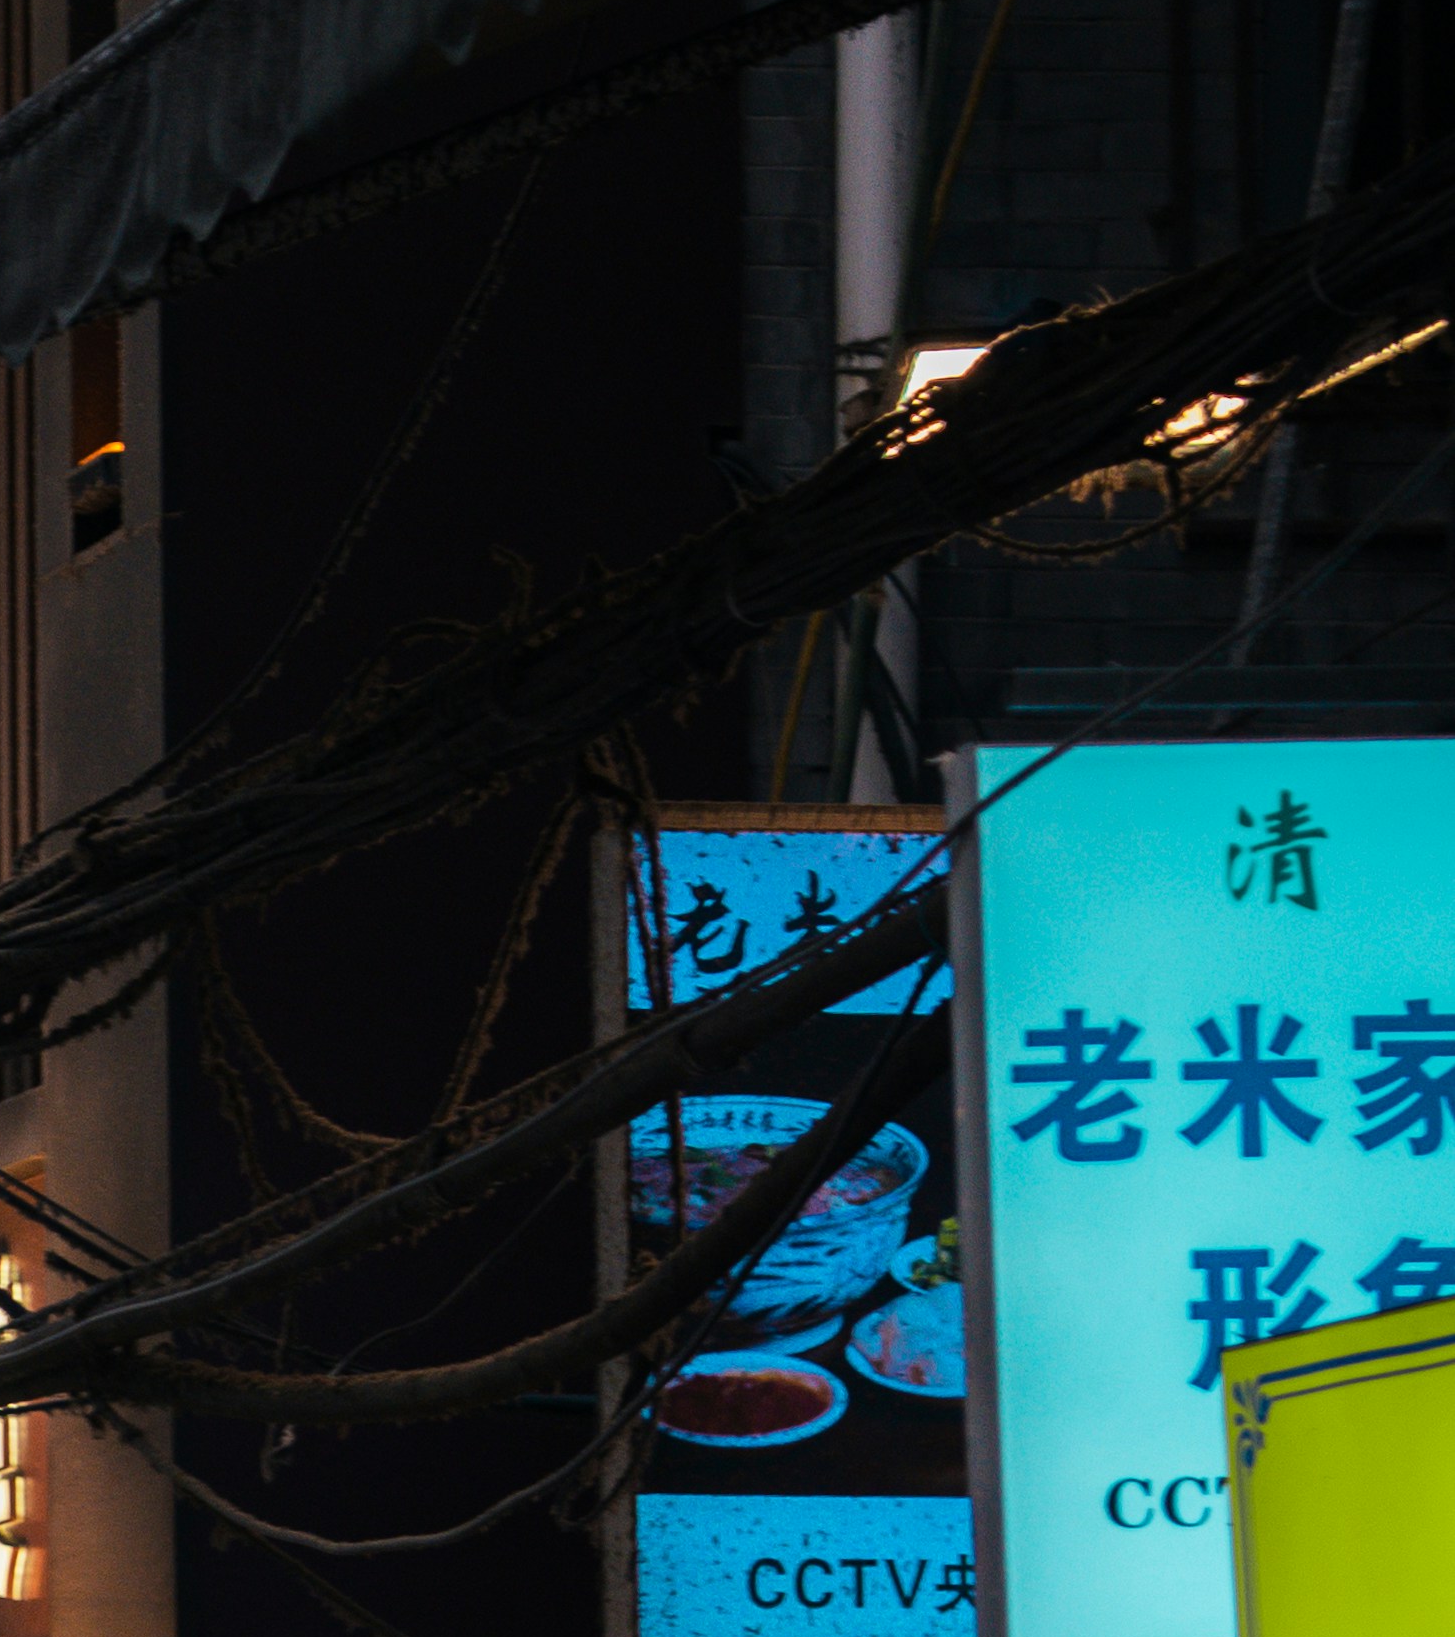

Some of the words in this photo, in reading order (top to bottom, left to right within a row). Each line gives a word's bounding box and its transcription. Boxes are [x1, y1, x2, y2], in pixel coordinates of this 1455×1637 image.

[1224, 789, 1329, 912] 清
[1009, 998, 1455, 1164] 老米家
[1105, 1476, 1229, 1529] CC
